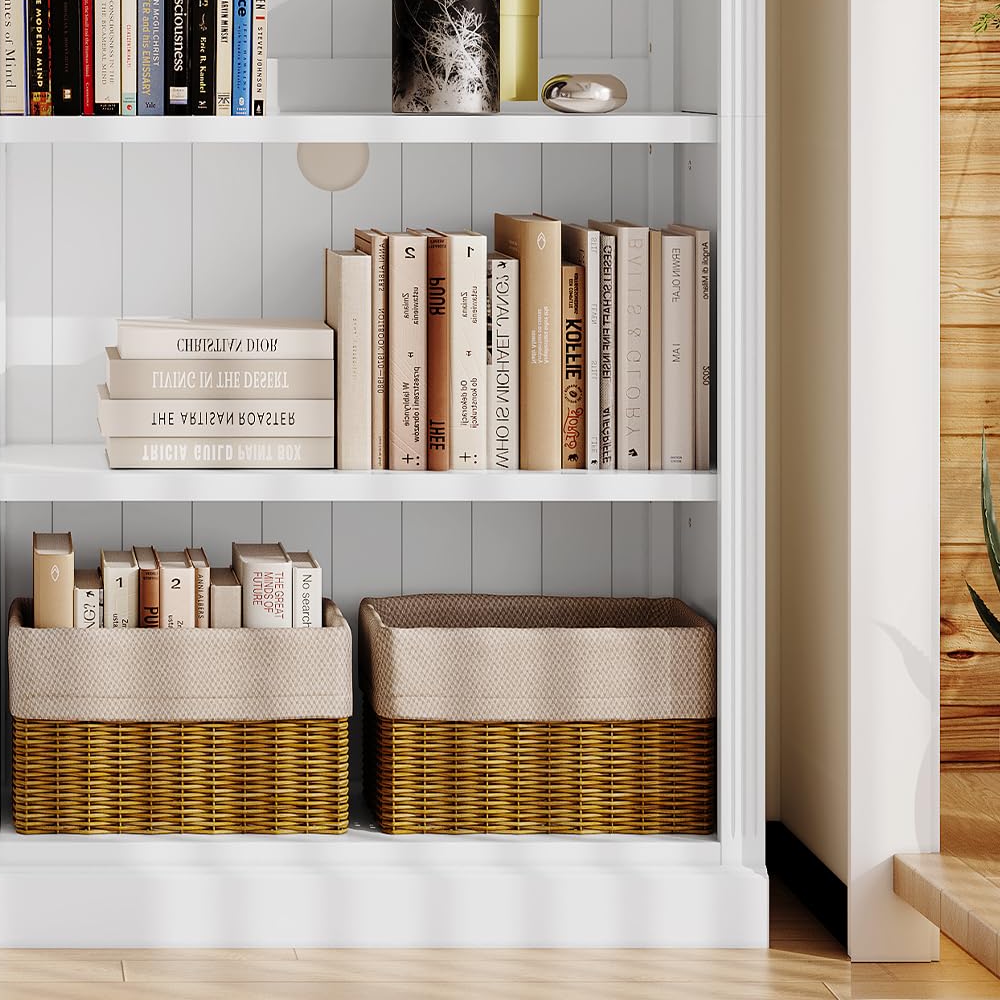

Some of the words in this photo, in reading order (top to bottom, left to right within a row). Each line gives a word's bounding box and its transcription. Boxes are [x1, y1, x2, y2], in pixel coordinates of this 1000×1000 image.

[143, 17, 151, 32] and
[5, 32, 13, 46] of
[143, 34, 151, 48] his
[200, 53, 207, 63] R.
[5, 48, 17, 88] Mind
[142, 50, 151, 96] EMISSARY
[116, 578, 123, 588] 1
[171, 578, 180, 589] 2
[264, 572, 273, 600] MINDS
[275, 572, 284, 589] THE
[302, 575, 312, 590] No
[253, 572, 262, 606] FUTURE
[264, 601, 273, 613] OF
[275, 591, 284, 619] GREAT
